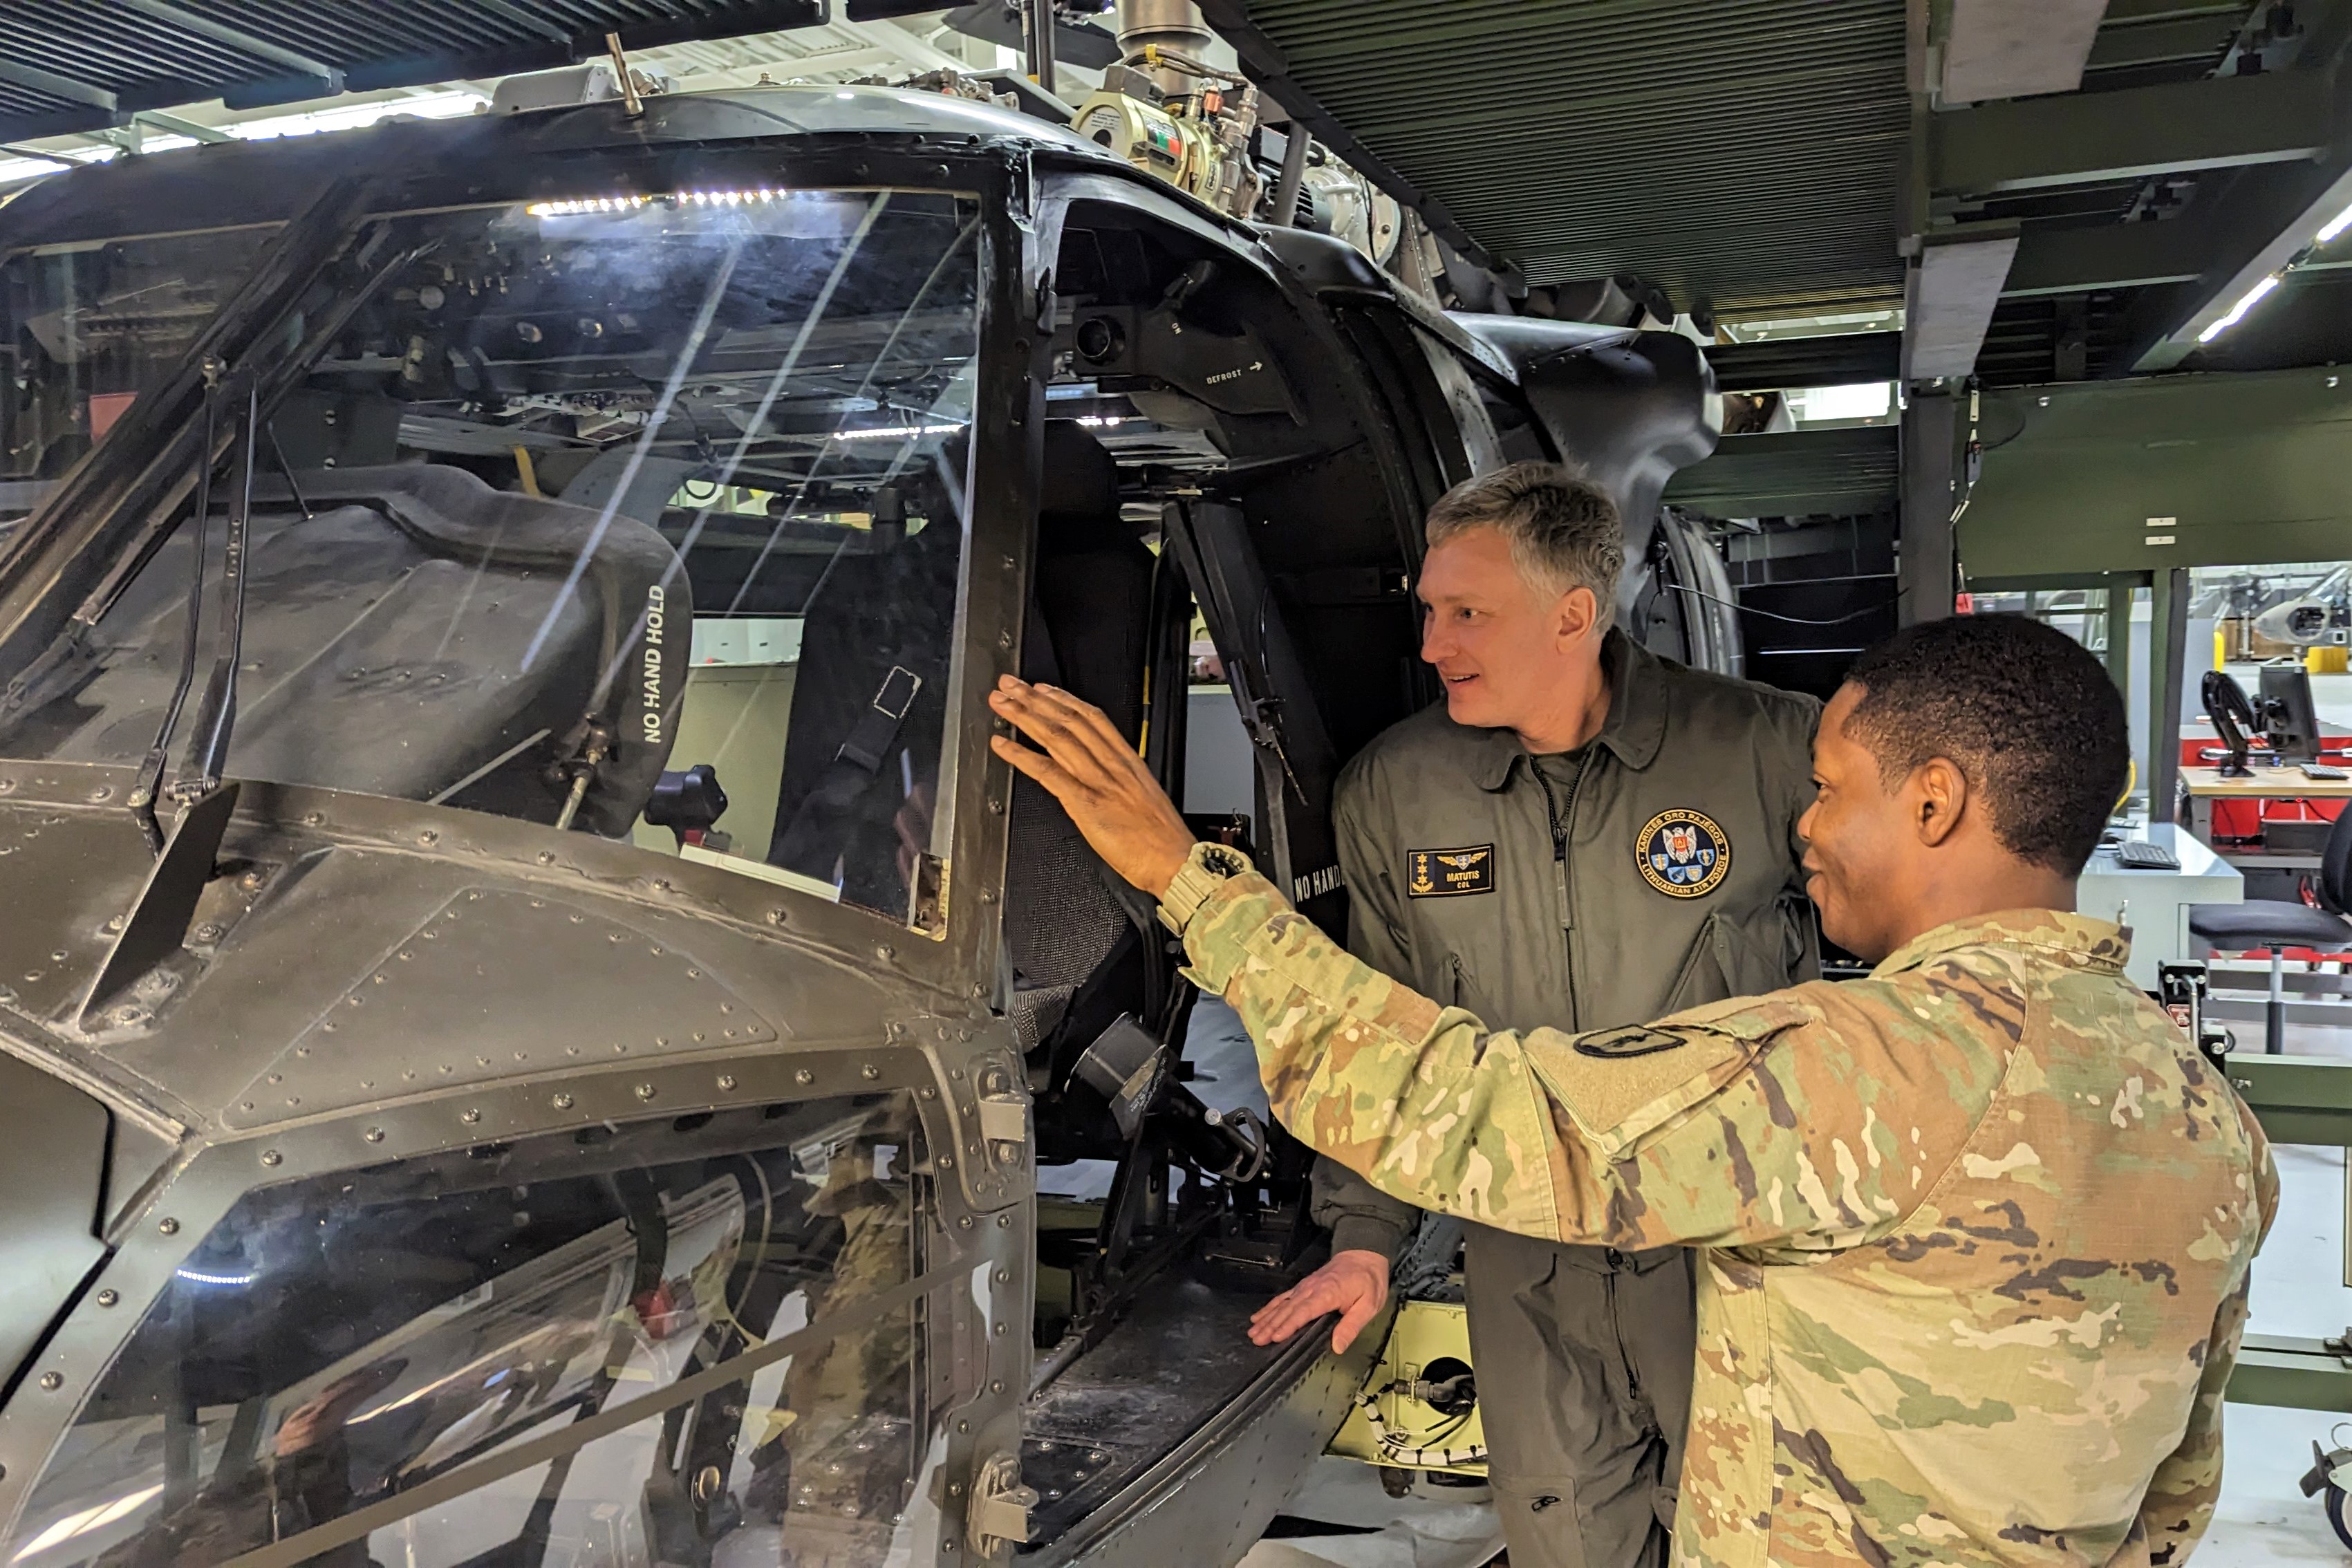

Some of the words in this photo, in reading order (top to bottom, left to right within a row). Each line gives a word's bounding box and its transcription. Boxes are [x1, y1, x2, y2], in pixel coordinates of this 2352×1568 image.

[1206, 368, 1242, 385] DEFROST
[646, 585, 665, 644] HOLD
[644, 648, 662, 709] HAND
[643, 713, 661, 744] NO
[1664, 812, 1686, 821] ORO
[1294, 875, 1311, 903] NO
[1312, 864, 1341, 897] HAND
[1446, 870, 1480, 882] MATUTIS
[1642, 864, 1691, 895] LITHUANIAN
[1693, 882, 1709, 893] AIR
[1708, 855, 1727, 884] FORCE
